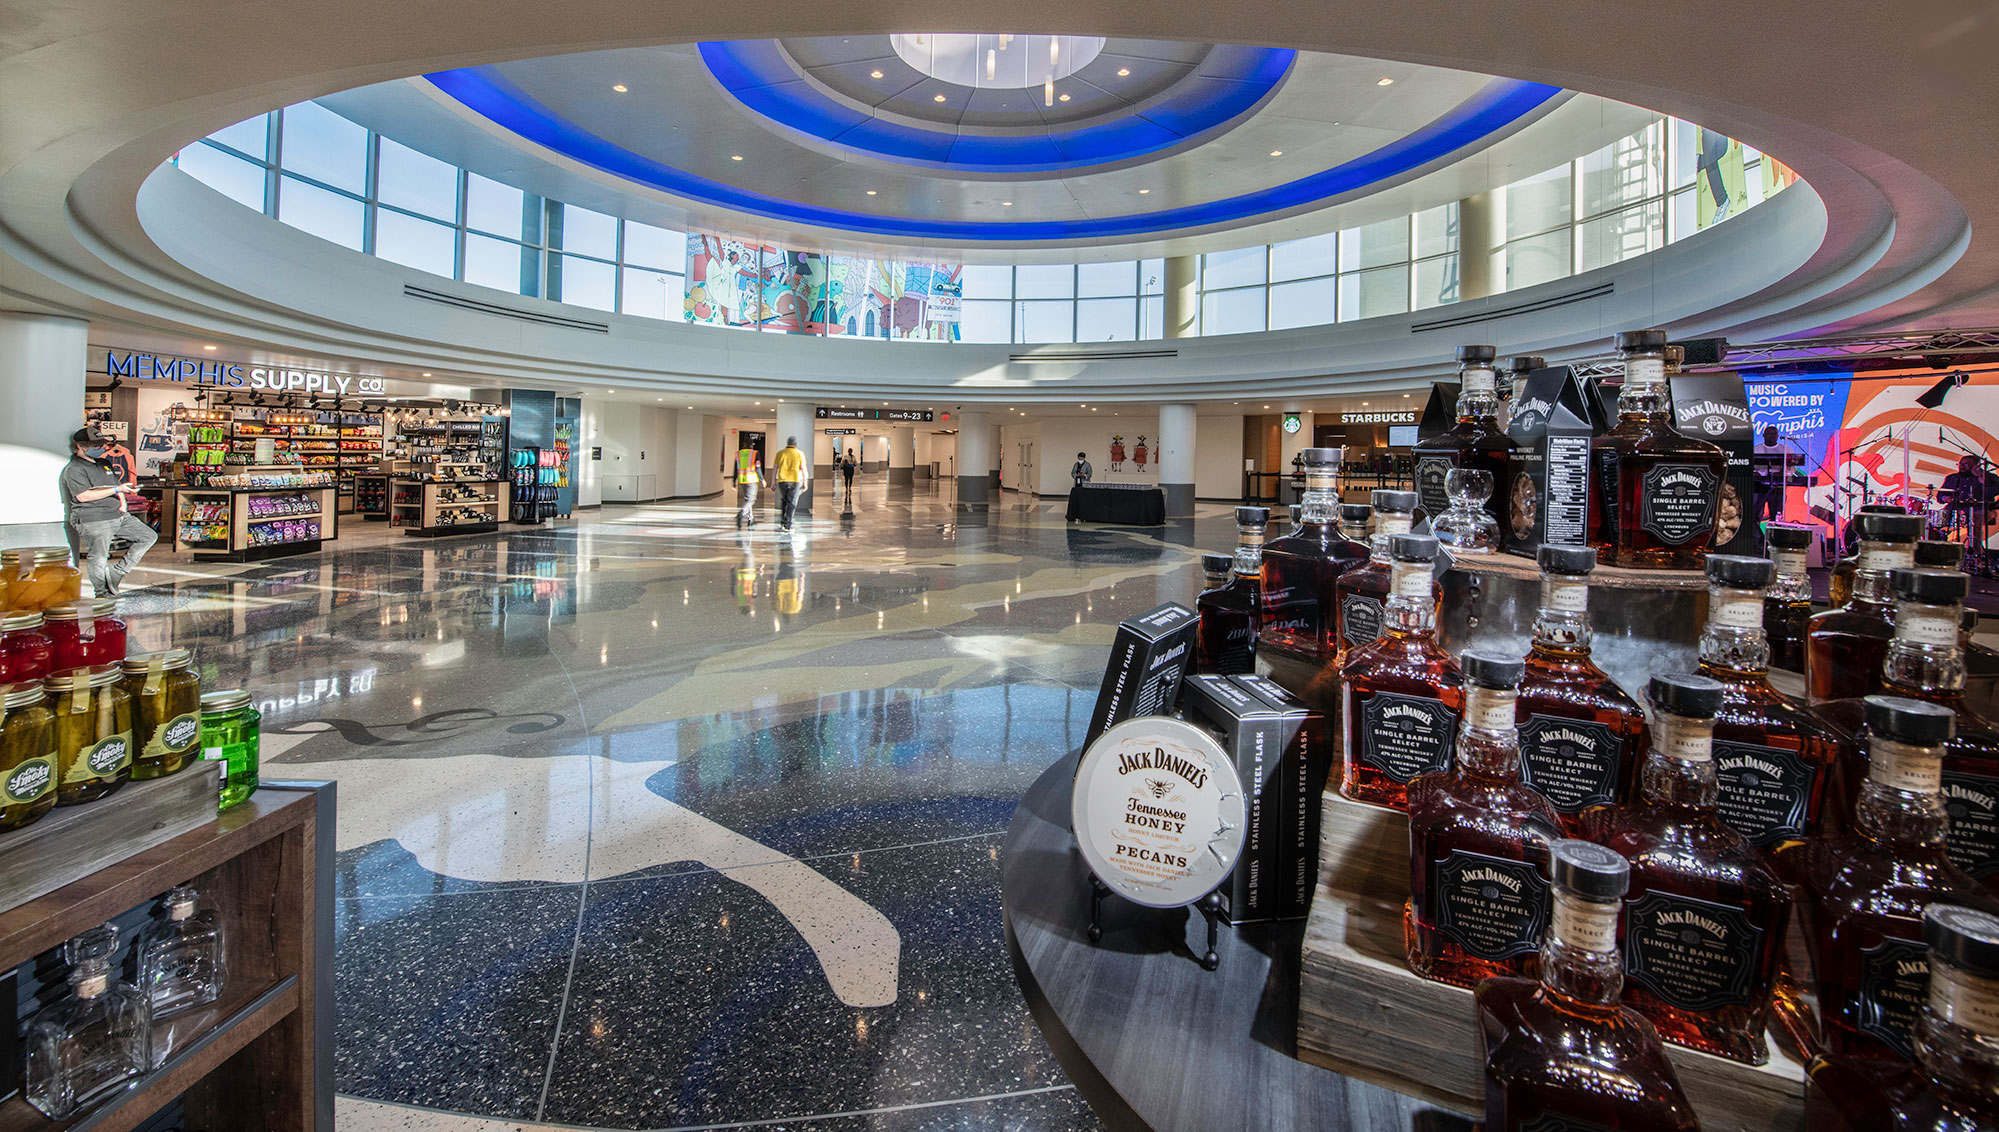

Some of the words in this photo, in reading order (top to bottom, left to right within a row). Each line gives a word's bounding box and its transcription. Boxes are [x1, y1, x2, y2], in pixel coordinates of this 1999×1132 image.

[107, 351, 245, 388] MEMPHIS
[250, 368, 351, 394] SUPPLY
[1750, 384, 1788, 396] MUSIC
[1515, 400, 1531, 419] JACK
[1750, 395, 1807, 407] POWERED
[1810, 394, 1825, 406] BY
[1341, 412, 1415, 423] STARBUCKS
[1678, 404, 1706, 422] JACK
[102, 422, 127, 430] SELF
[1752, 415, 1825, 435] Mmphis
[1661, 474, 1677, 487] JACK
[1677, 471, 1702, 488] DANIEL'S
[1352, 603, 1360, 611] JACK
[1115, 670, 1128, 694] STEEL
[1123, 643, 1136, 669] FLASK
[1149, 653, 1167, 671] JACK
[1383, 706, 1403, 719] JACK
[1402, 704, 1433, 726] DANIEL'S
[165, 720, 197, 741] Smoky
[1374, 729, 1404, 739] SINGLE
[1406, 734, 1439, 744] BARREL
[1255, 731, 1264, 764] FLASK
[1300, 730, 1308, 761] FLASK
[1392, 739, 1420, 748] SELECT
[1540, 730, 1562, 743] JACK
[1562, 728, 1597, 752] DANIEL'S
[1676, 740, 1703, 748] SELECT
[91, 742, 126, 765] Smoky
[1378, 744, 1408, 753] TENNESSEE
[1409, 749, 1433, 757] WHISKEY
[1118, 751, 1152, 776] JACK
[1154, 747, 1208, 789] DANIEL'S
[1530, 754, 1563, 765] SINGLE
[1566, 760, 1604, 772] BARREL
[1550, 765, 1582, 775] SELECT
[1719, 757, 1744, 771] JACK
[1744, 754, 1784, 780] DANIEL'S
[8, 765, 50, 791] Smoky
[1254, 764, 1263, 796] STEEL
[1299, 762, 1307, 793] STEEL
[1534, 770, 1568, 780] TENNESSEE
[1569, 775, 1597, 785] WHISKEY
[1905, 771, 1936, 779] SELECT
[1547, 788, 1582, 797] LYNCHBURG
[1717, 784, 1745, 794] NGLE
[1749, 789, 1792, 802] BARREL
[1730, 794, 1766, 805] SELECT
[1127, 797, 1187, 821] Tennessee
[1715, 801, 1750, 811] ENNESSEE
[1752, 806, 1784, 816] WHISKEY
[1125, 813, 1186, 834] HONEY
[1252, 798, 1261, 850] STAINLESS
[1298, 796, 1306, 848] STAINLESS
[1726, 819, 1765, 829] LYNCHBURG
[1956, 821, 1999, 834] BARRE
[1128, 827, 1150, 837] HONEY
[1151, 831, 1180, 842] LIQUEUR
[1948, 829, 1976, 838] LECT
[1109, 856, 1127, 865] MADE
[1128, 860, 1144, 868] WITH
[1145, 863, 1161, 872] JACK
[1116, 844, 1187, 868] PECANS
[1119, 865, 1155, 877] TENNESSEE
[1461, 869, 1485, 883] JACK
[1485, 867, 1523, 894] DANIEL'S
[1248, 889, 1258, 908] JACK
[1450, 894, 1486, 908] SINGLE
[1489, 902, 1531, 917] BARREL
[1455, 912, 1491, 924] TENNESSEE
[1493, 919, 1523, 931] WHISKEY
[1472, 907, 1506, 919] SELECT
[1573, 926, 1604, 937] SELECT
[1656, 911, 1685, 926] JACK
[1684, 909, 1729, 940] DANIEL'S
[1469, 932, 1506, 944] LYNCHBURG
[1642, 937, 1685, 953] SINGLE
[1689, 947, 1737, 965] BARREL
[1668, 952, 1708, 967] SELECT
[1647, 957, 1690, 971] TENNESSEE
[1693, 967, 1728, 980] WHISKEY
[1896, 960, 1930, 976] JACK
